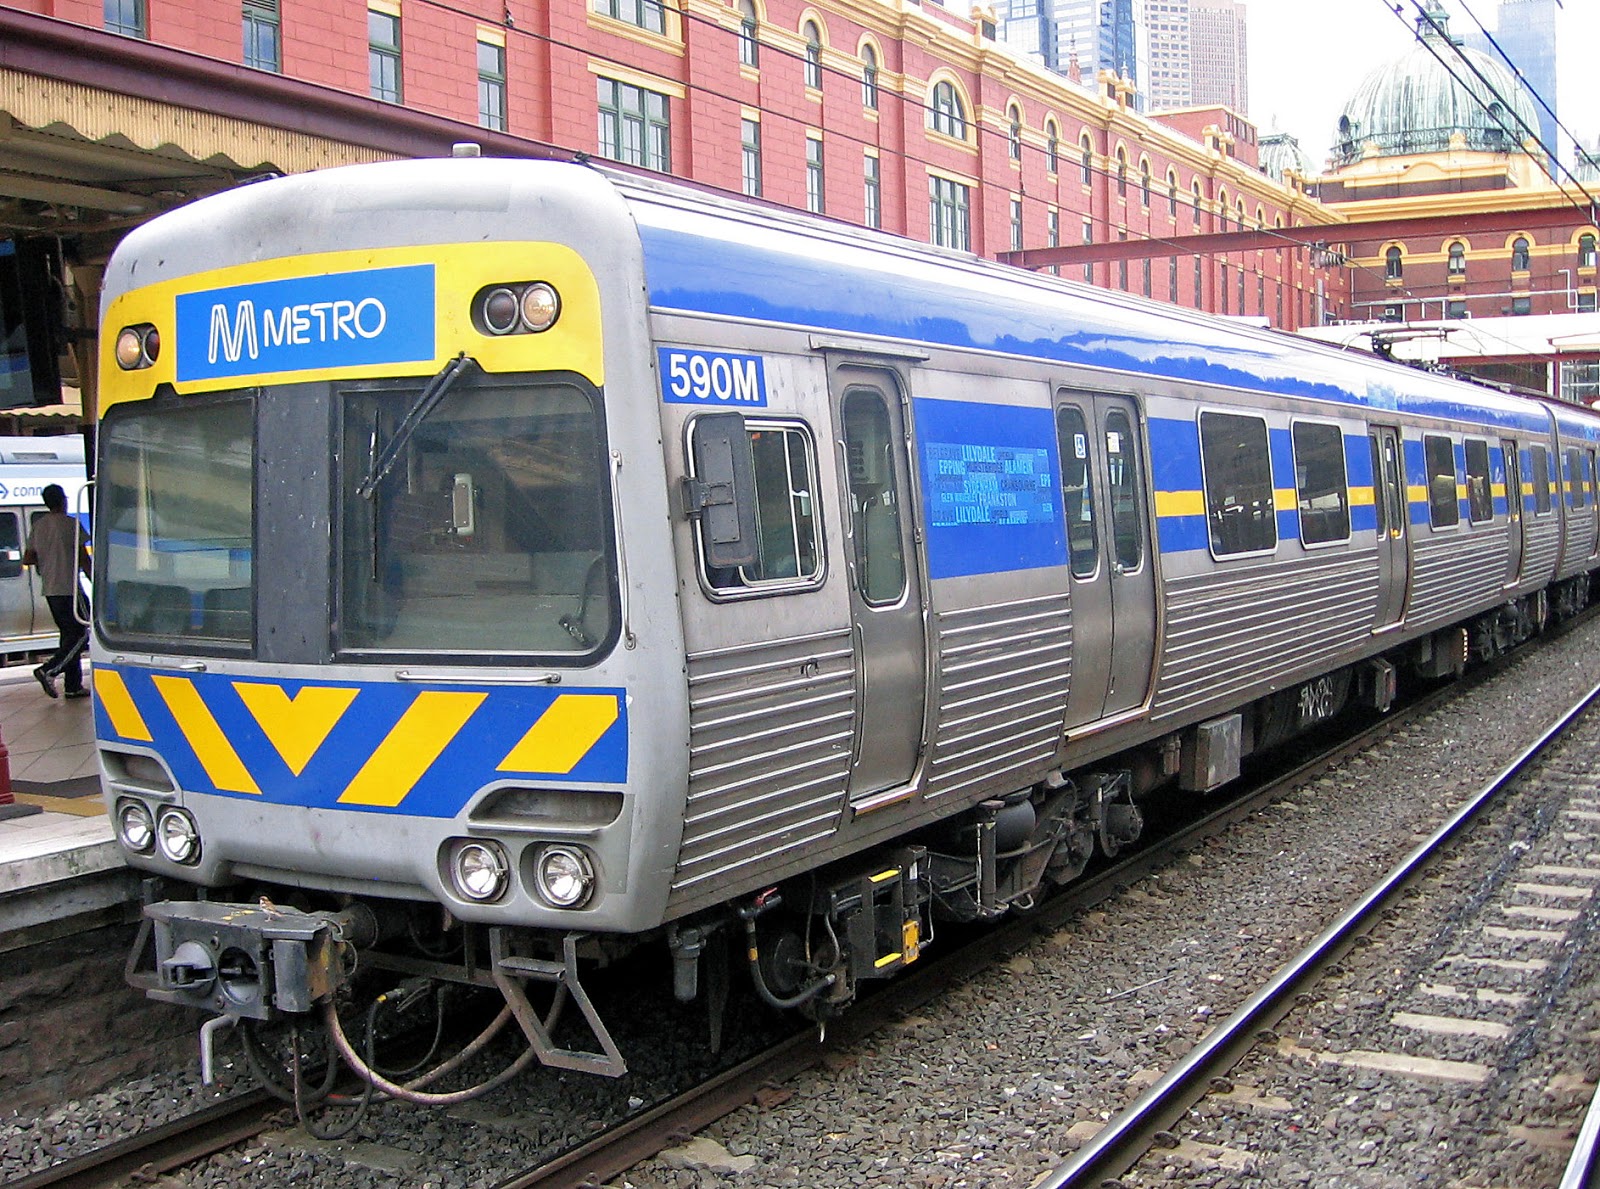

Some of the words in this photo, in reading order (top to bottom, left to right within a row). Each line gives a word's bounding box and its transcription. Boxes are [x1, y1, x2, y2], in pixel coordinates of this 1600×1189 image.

[263, 297, 387, 347] METRO
[670, 353, 760, 402] 590M
[961, 444, 996, 463] LILYDALE
[939, 459, 966, 475] EPPING
[1004, 459, 1034, 474] ALAMEIN
[963, 479, 999, 494] SYDENHAM
[977, 492, 1017, 507] FRANKSTON
[954, 505, 991, 523] LILYDALE
